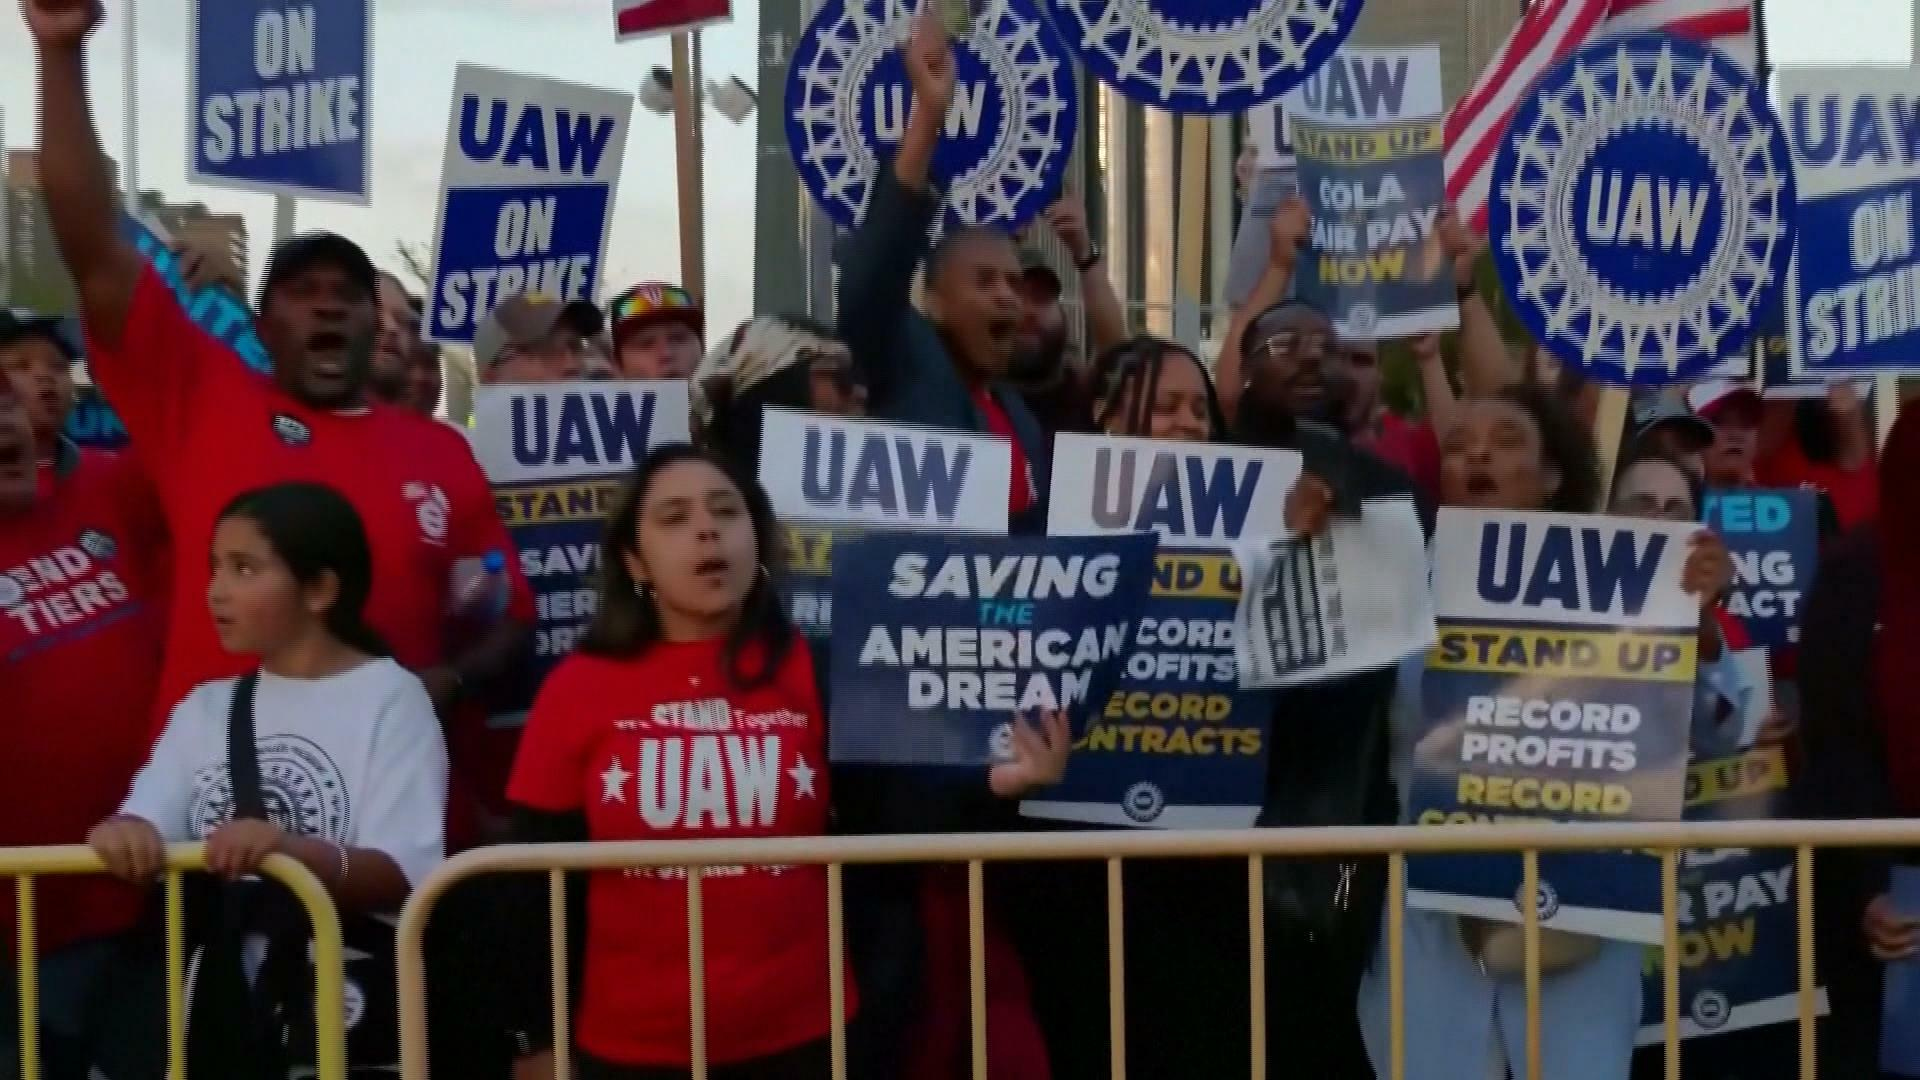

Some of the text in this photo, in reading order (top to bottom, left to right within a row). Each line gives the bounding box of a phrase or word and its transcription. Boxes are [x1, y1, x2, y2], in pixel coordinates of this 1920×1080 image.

[253, 4, 316, 79] ON
[873, 82, 986, 140] UW
[1302, 56, 1408, 120] UAW
[203, 75, 359, 163] STRIKE
[458, 93, 615, 178] UAW
[1386, 124, 1433, 152] UP
[1319, 173, 1407, 210] COLA
[1585, 169, 1708, 255] UAW
[494, 196, 556, 259] ON
[1366, 202, 1440, 248] PAY
[1849, 191, 1912, 271] ON
[1318, 248, 1406, 285] NOW
[511, 391, 657, 467] UAW
[801, 425, 973, 525] UAW
[1091, 447, 1263, 541] UAW
[888, 551, 1121, 600] SAVING
[1477, 520, 1669, 617] UAW
[4, 570, 129, 634] TIERS
[977, 602, 1034, 626] THE
[859, 621, 1130, 669] AMERICAN
[1136, 617, 1237, 649] CORD
[1438, 633, 1681, 673] STAND UP
[908, 670, 1093, 712] DREAM
[1127, 651, 1236, 682] OFITS
[651, 697, 732, 732] STAND
[1104, 690, 1232, 721] ECORD
[1465, 696, 1642, 735] RECORD
[1460, 734, 1638, 773] PROFITS
[637, 735, 781, 829] UAW
[1456, 774, 1634, 815] RECORD
[1701, 864, 1794, 920] PAY
